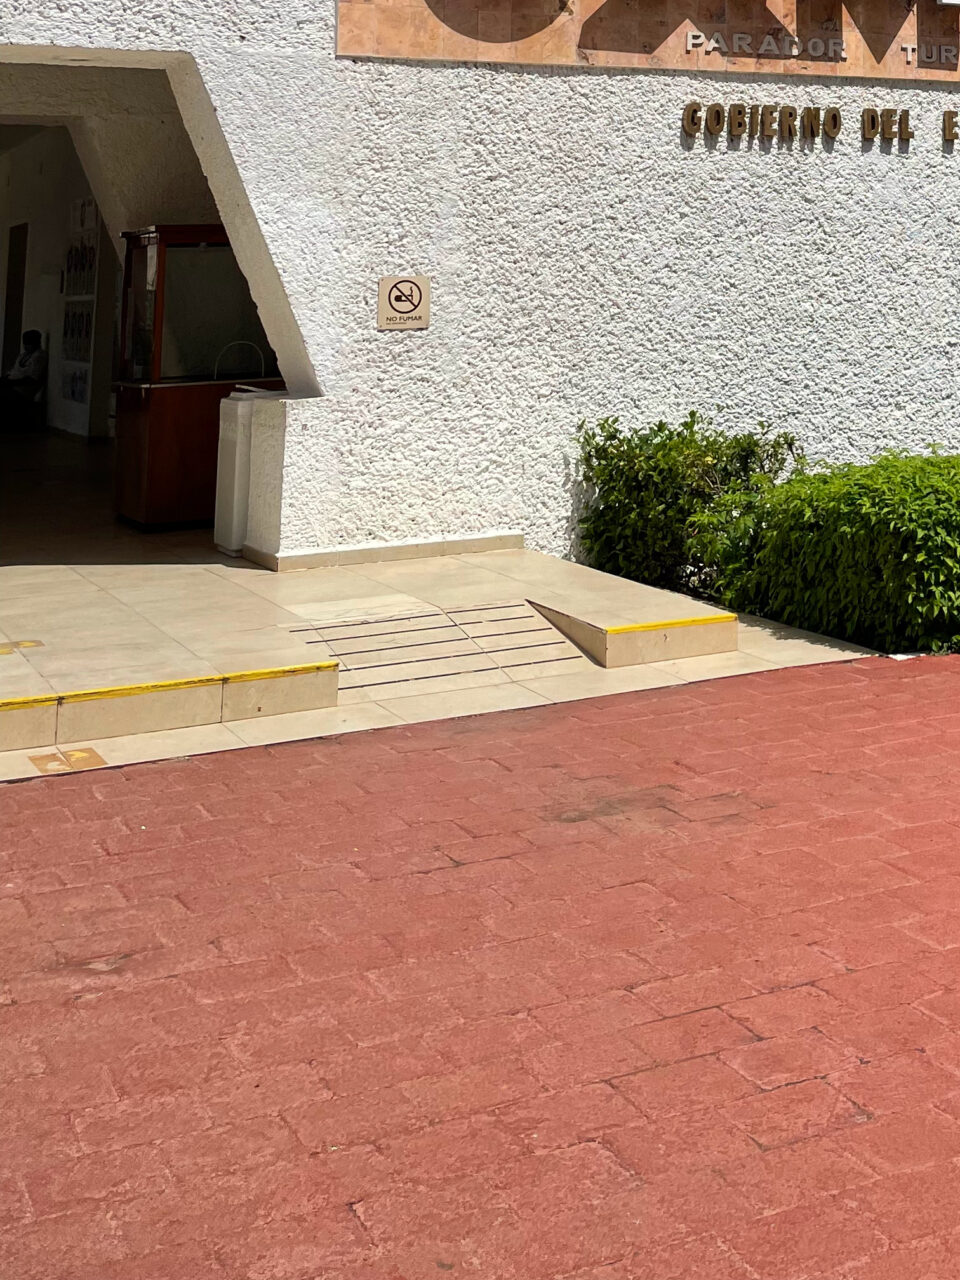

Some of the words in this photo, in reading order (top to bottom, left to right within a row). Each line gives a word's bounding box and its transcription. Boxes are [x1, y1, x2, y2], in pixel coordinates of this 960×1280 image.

[686, 32, 847, 60] PARADOR
[682, 102, 841, 138] GOBIERNO
[862, 108, 914, 139] DEL
